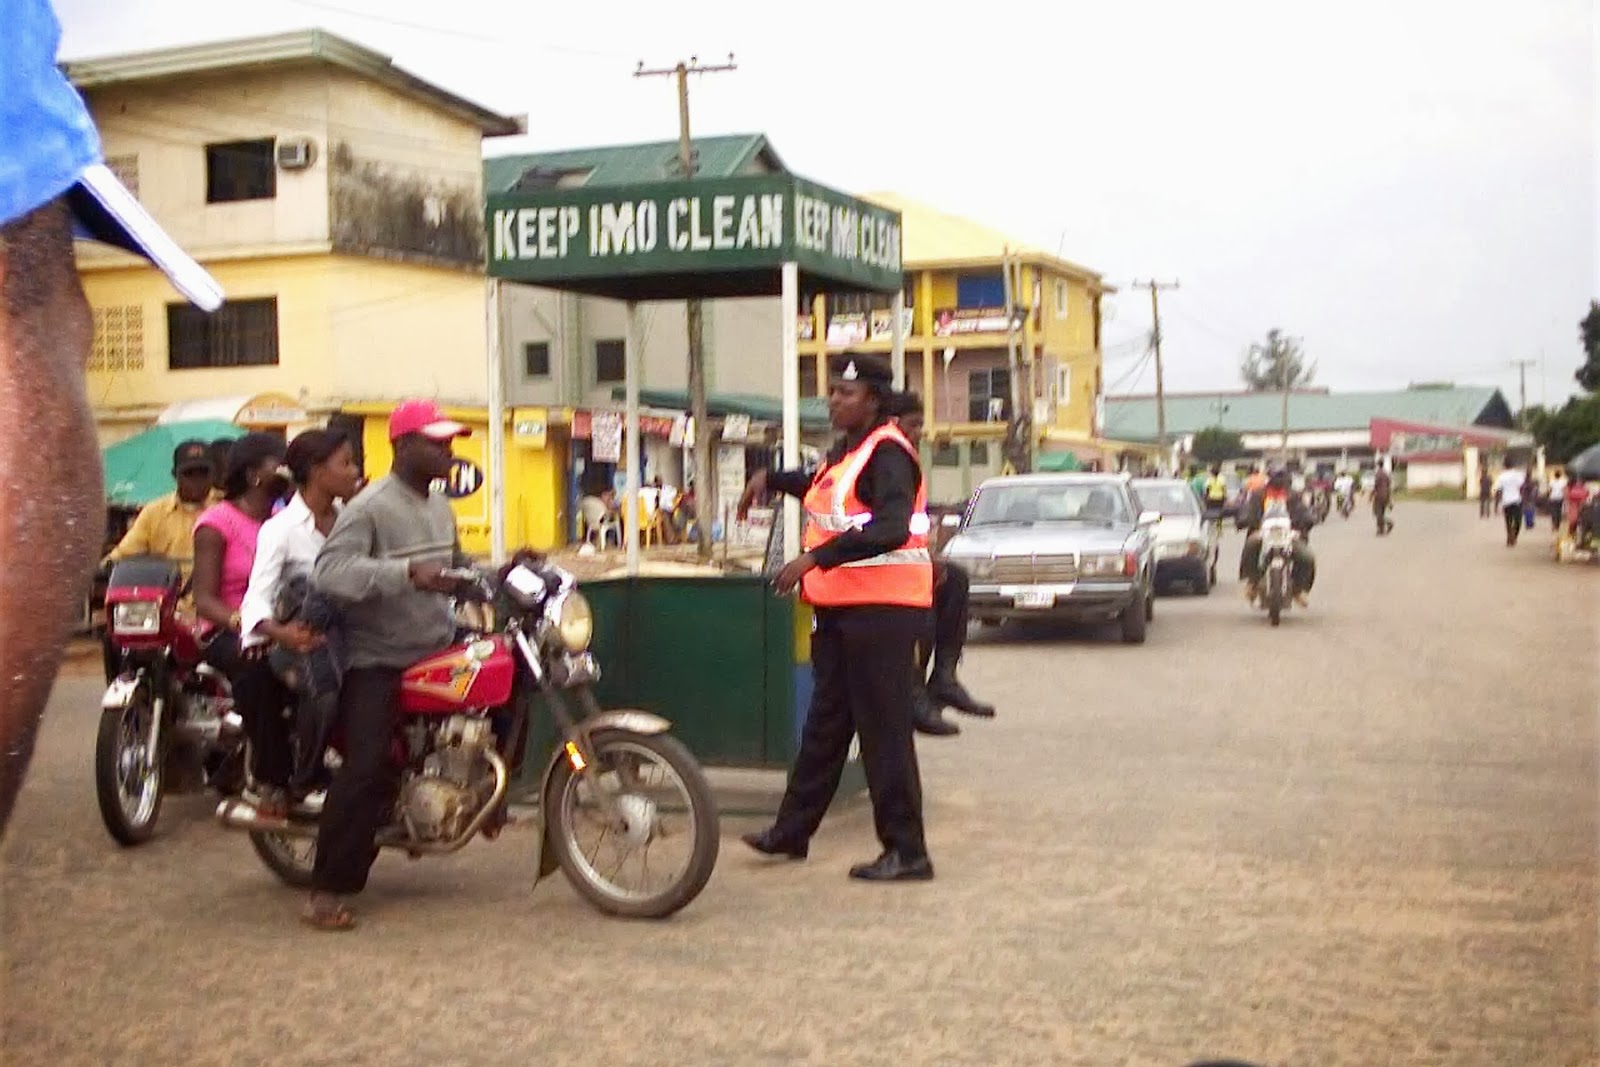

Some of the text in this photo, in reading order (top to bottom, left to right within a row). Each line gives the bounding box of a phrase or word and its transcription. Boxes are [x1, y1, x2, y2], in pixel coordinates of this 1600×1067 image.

[494, 194, 783, 261] KEEP IMO CLEAN
[794, 194, 901, 273] KEEP IMO CLEAN
